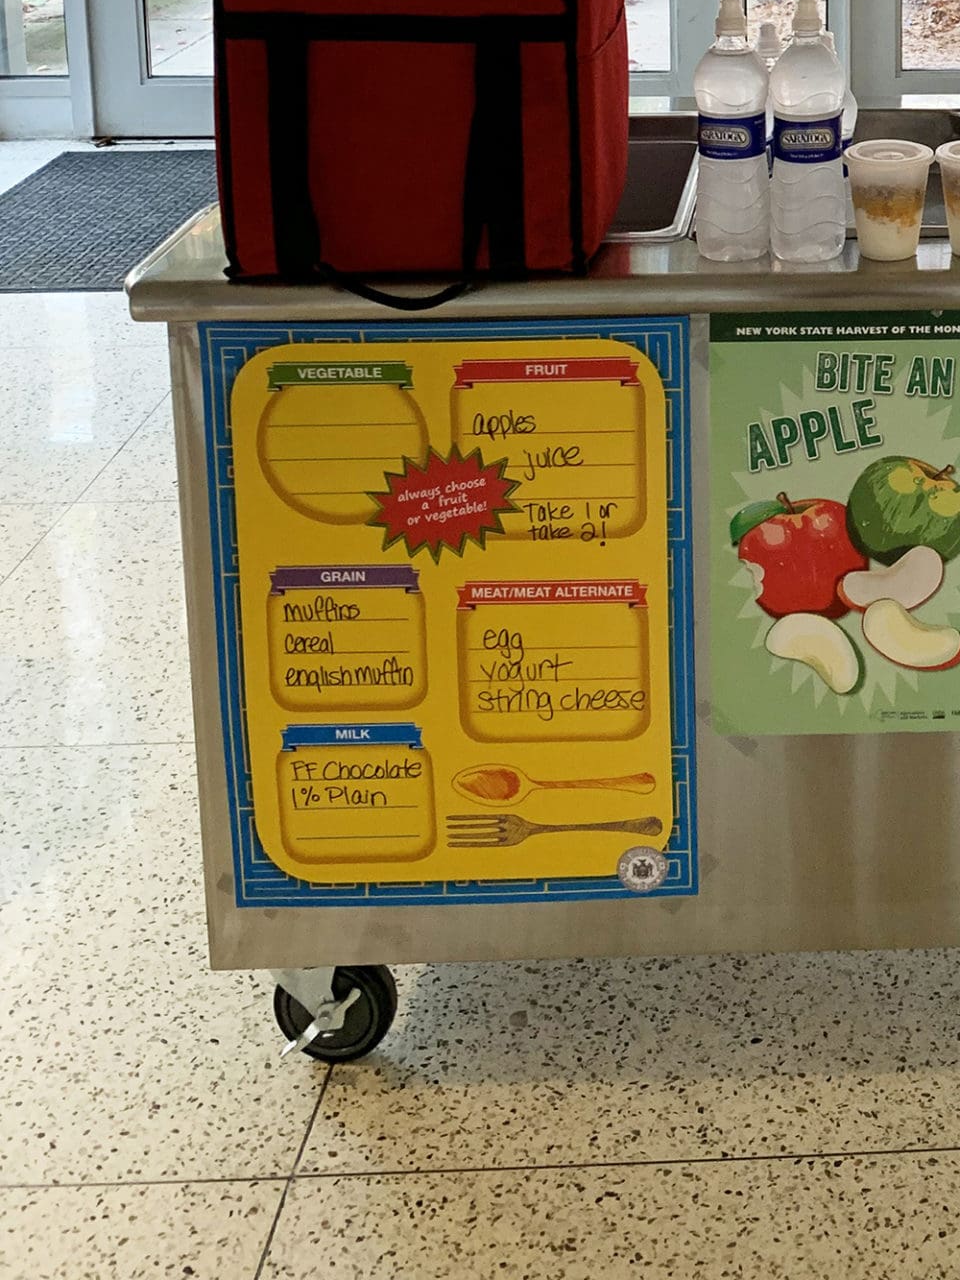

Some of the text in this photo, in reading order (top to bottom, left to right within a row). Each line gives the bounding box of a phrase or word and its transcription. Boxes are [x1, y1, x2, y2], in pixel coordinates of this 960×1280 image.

[736, 327, 762, 336] NEW
[765, 327, 798, 336] YORK
[800, 327, 834, 335] STATE
[836, 326, 888, 335] HARVEST
[891, 325, 906, 334] OF
[909, 325, 930, 334] THE
[297, 366, 383, 380] VEGETABLE
[525, 364, 568, 377] FRUIT
[816, 352, 955, 397] BITE AN
[473, 409, 537, 442] apples
[747, 400, 882, 472] APPLE
[523, 443, 584, 481] juice
[398, 476, 487, 505] always choose
[421, 492, 468, 510] a fruit
[407, 500, 488, 525] or vegetable!
[599, 503, 618, 520] or
[530, 524, 572, 542] take
[320, 571, 366, 584] GRAIN
[471, 583, 634, 598] MEAT/MEAT ALTERNATE
[283, 594, 361, 623] muffins
[284, 631, 334, 654] cereal
[483, 629, 523, 665] egg
[480, 654, 574, 690] yogurt
[477, 687, 646, 721] string cheese
[335, 729, 371, 740] MILK
[326, 758, 422, 781] Chocolate
[329, 787, 387, 808] Plain
